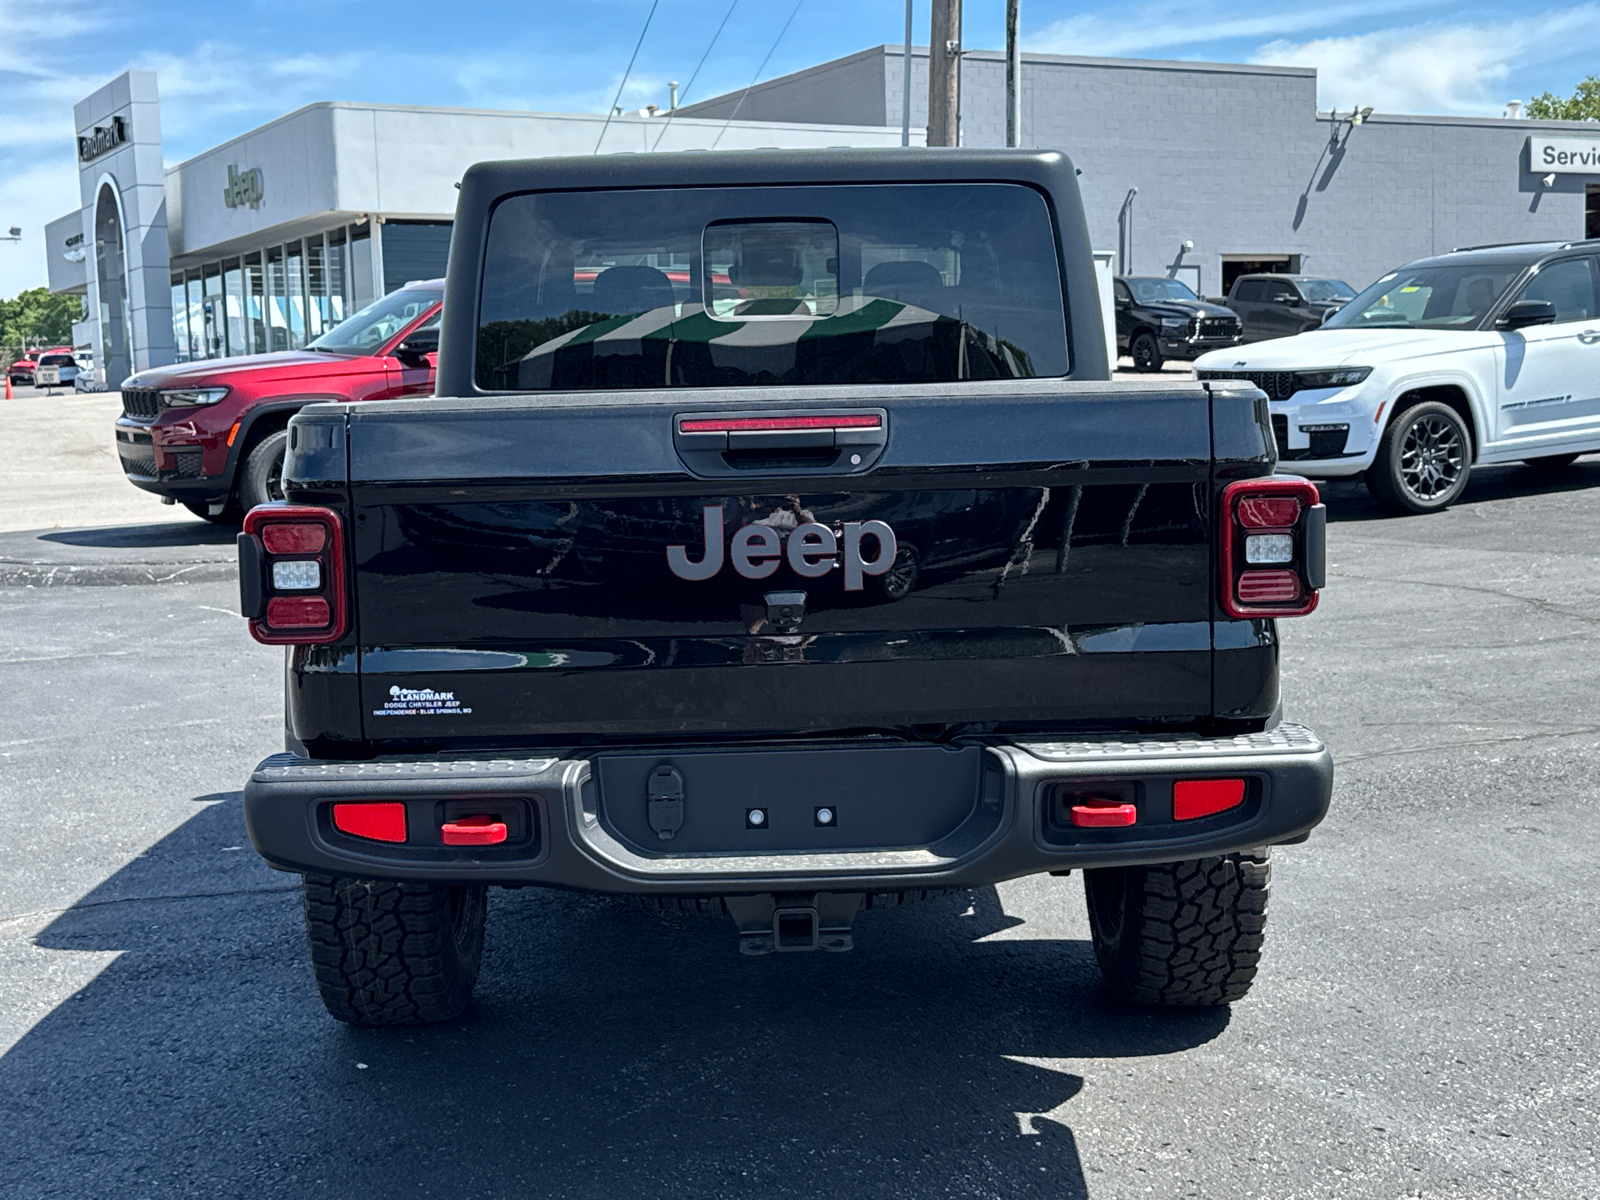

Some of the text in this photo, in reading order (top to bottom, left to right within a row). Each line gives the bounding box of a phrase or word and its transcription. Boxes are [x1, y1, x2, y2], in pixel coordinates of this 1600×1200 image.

[77, 115, 126, 163] Landmark
[1543, 145, 1600, 165] Servi
[223, 164, 264, 210] Jeep
[666, 505, 898, 591] Jeep
[400, 692, 454, 701] LANDMARK
